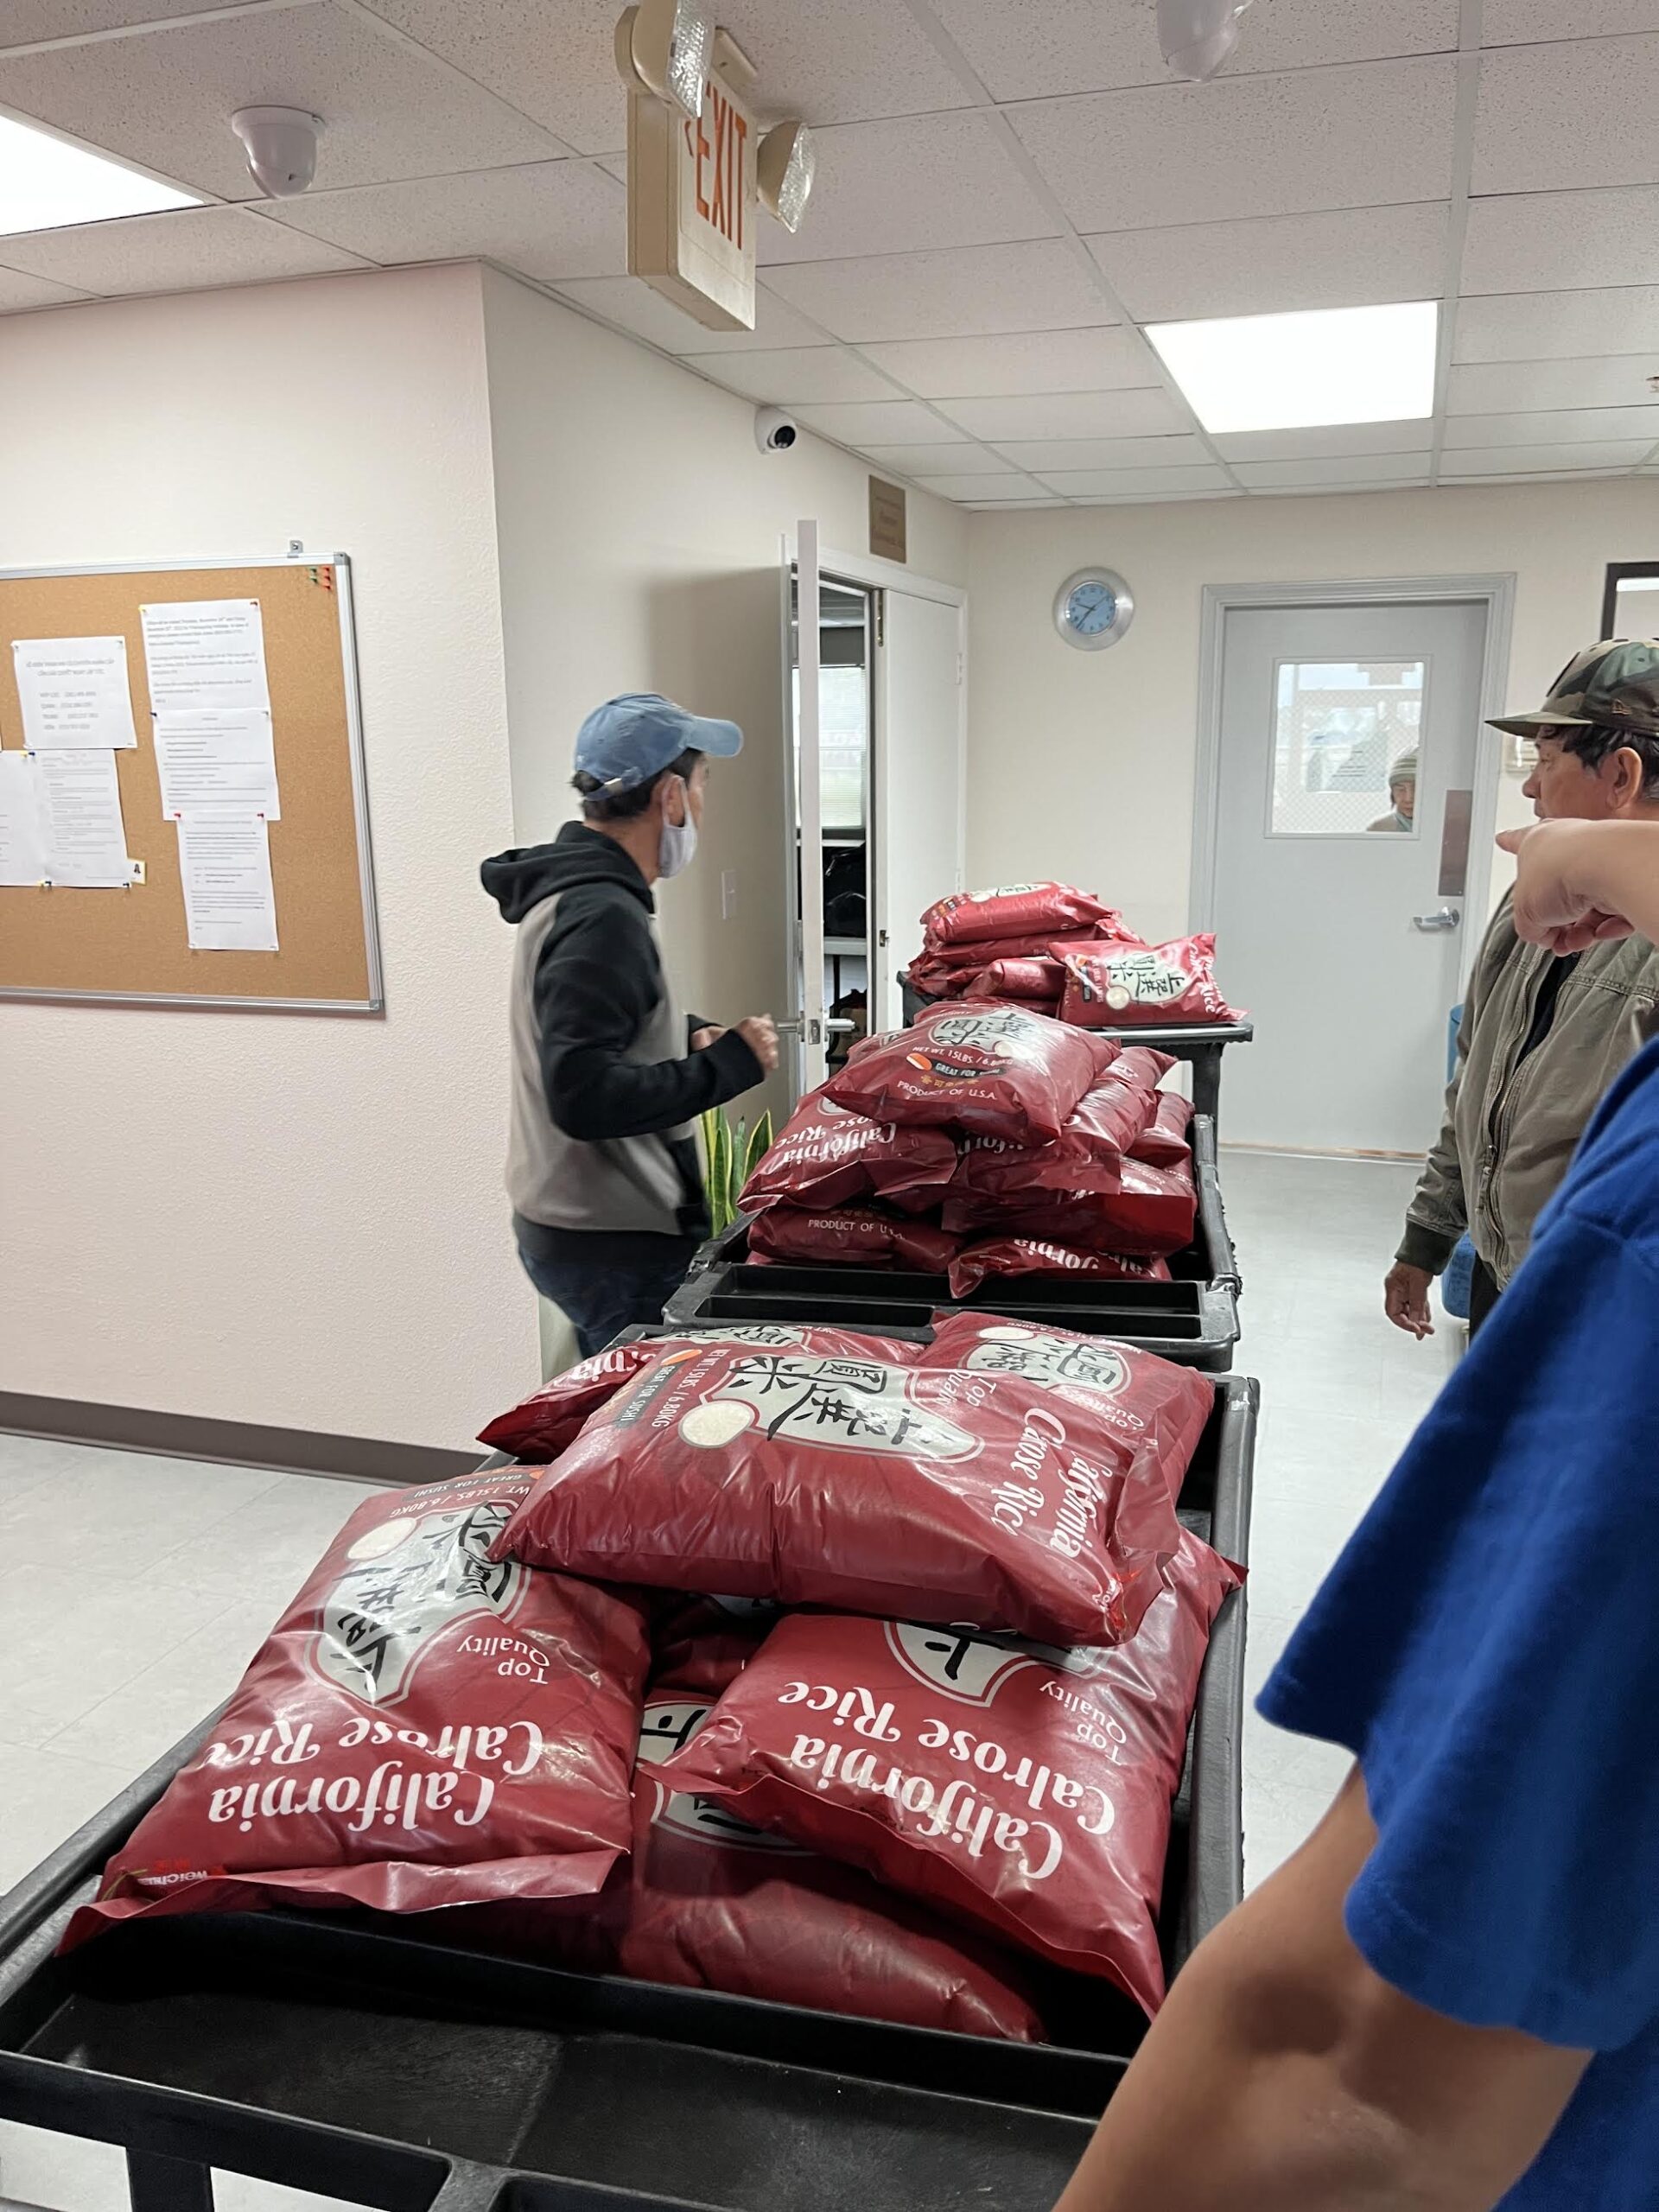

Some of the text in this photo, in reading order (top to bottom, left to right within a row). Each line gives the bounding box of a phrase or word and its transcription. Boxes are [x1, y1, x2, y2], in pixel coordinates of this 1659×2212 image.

[696, 81, 747, 251] EXIT
[897, 1080, 944, 1096] PRODUCT
[949, 1088, 964, 1096] OF
[935, 1063, 959, 1077] GREAT
[960, 1069, 976, 1077] FOR
[775, 1124, 827, 1150] Rice
[782, 1122, 897, 1166] California
[808, 1218, 856, 1232] PRODUCT
[860, 1222, 875, 1233] OF
[620, 1365, 676, 1422] GREAT FOR SUSHI
[965, 1377, 997, 1408] Top
[652, 1396, 685, 1428] 6.80KG
[1010, 1408, 1066, 1481] Carose
[415, 1484, 450, 1498] SUSHI
[485, 1473, 523, 1484] GREAT
[390, 1497, 442, 1519] 6.80KG
[991, 1480, 1046, 1536] Rice
[455, 1635, 550, 1667] Quality
[497, 1660, 550, 1686] Top
[1039, 1679, 1128, 1745] Quality
[205, 1715, 546, 1776] Calrose Rice
[777, 1680, 1116, 1837] Calrose Rice
[1075, 1721, 1128, 1766] Top
[207, 1760, 497, 1832] California
[789, 1732, 1065, 1881] California
